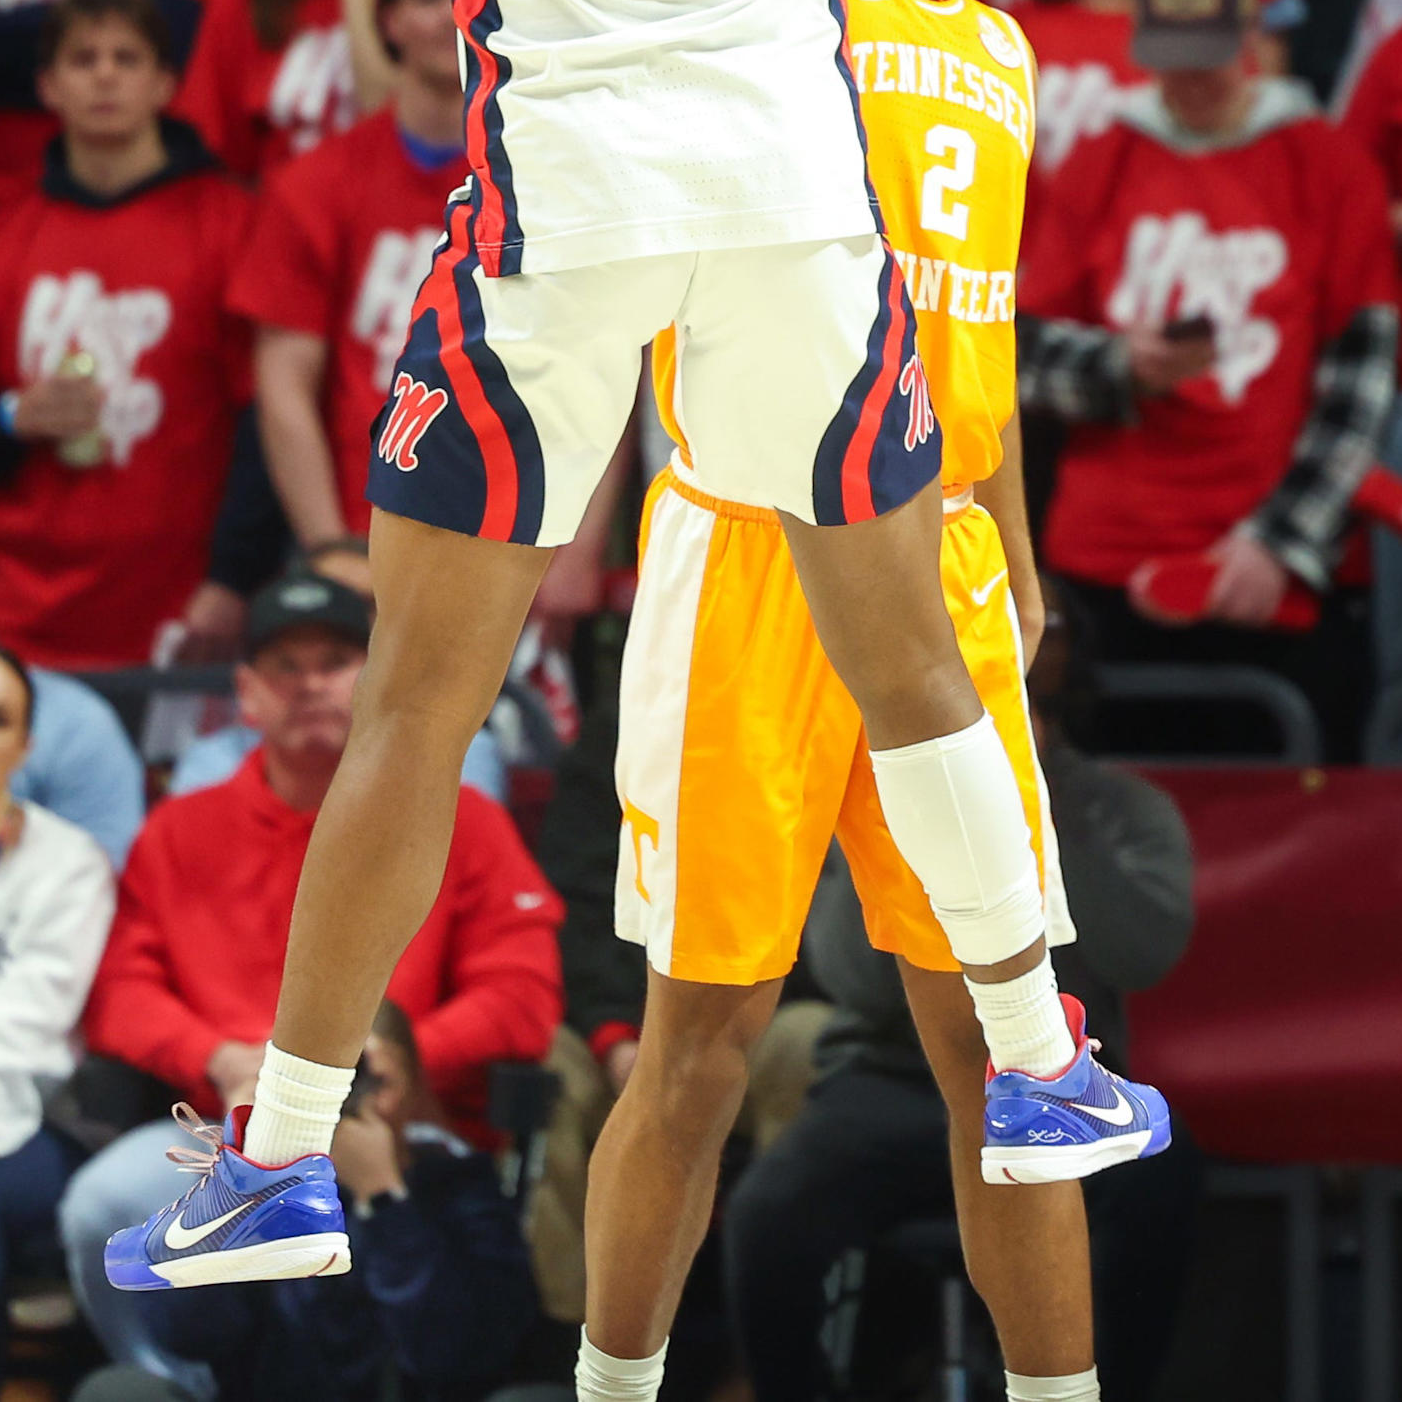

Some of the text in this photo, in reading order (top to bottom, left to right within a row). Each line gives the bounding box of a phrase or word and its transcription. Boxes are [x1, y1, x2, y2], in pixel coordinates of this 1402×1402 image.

[852, 41, 1029, 159] TENNESSEE
[920, 123, 976, 241] 2
[379, 371, 448, 472] M
